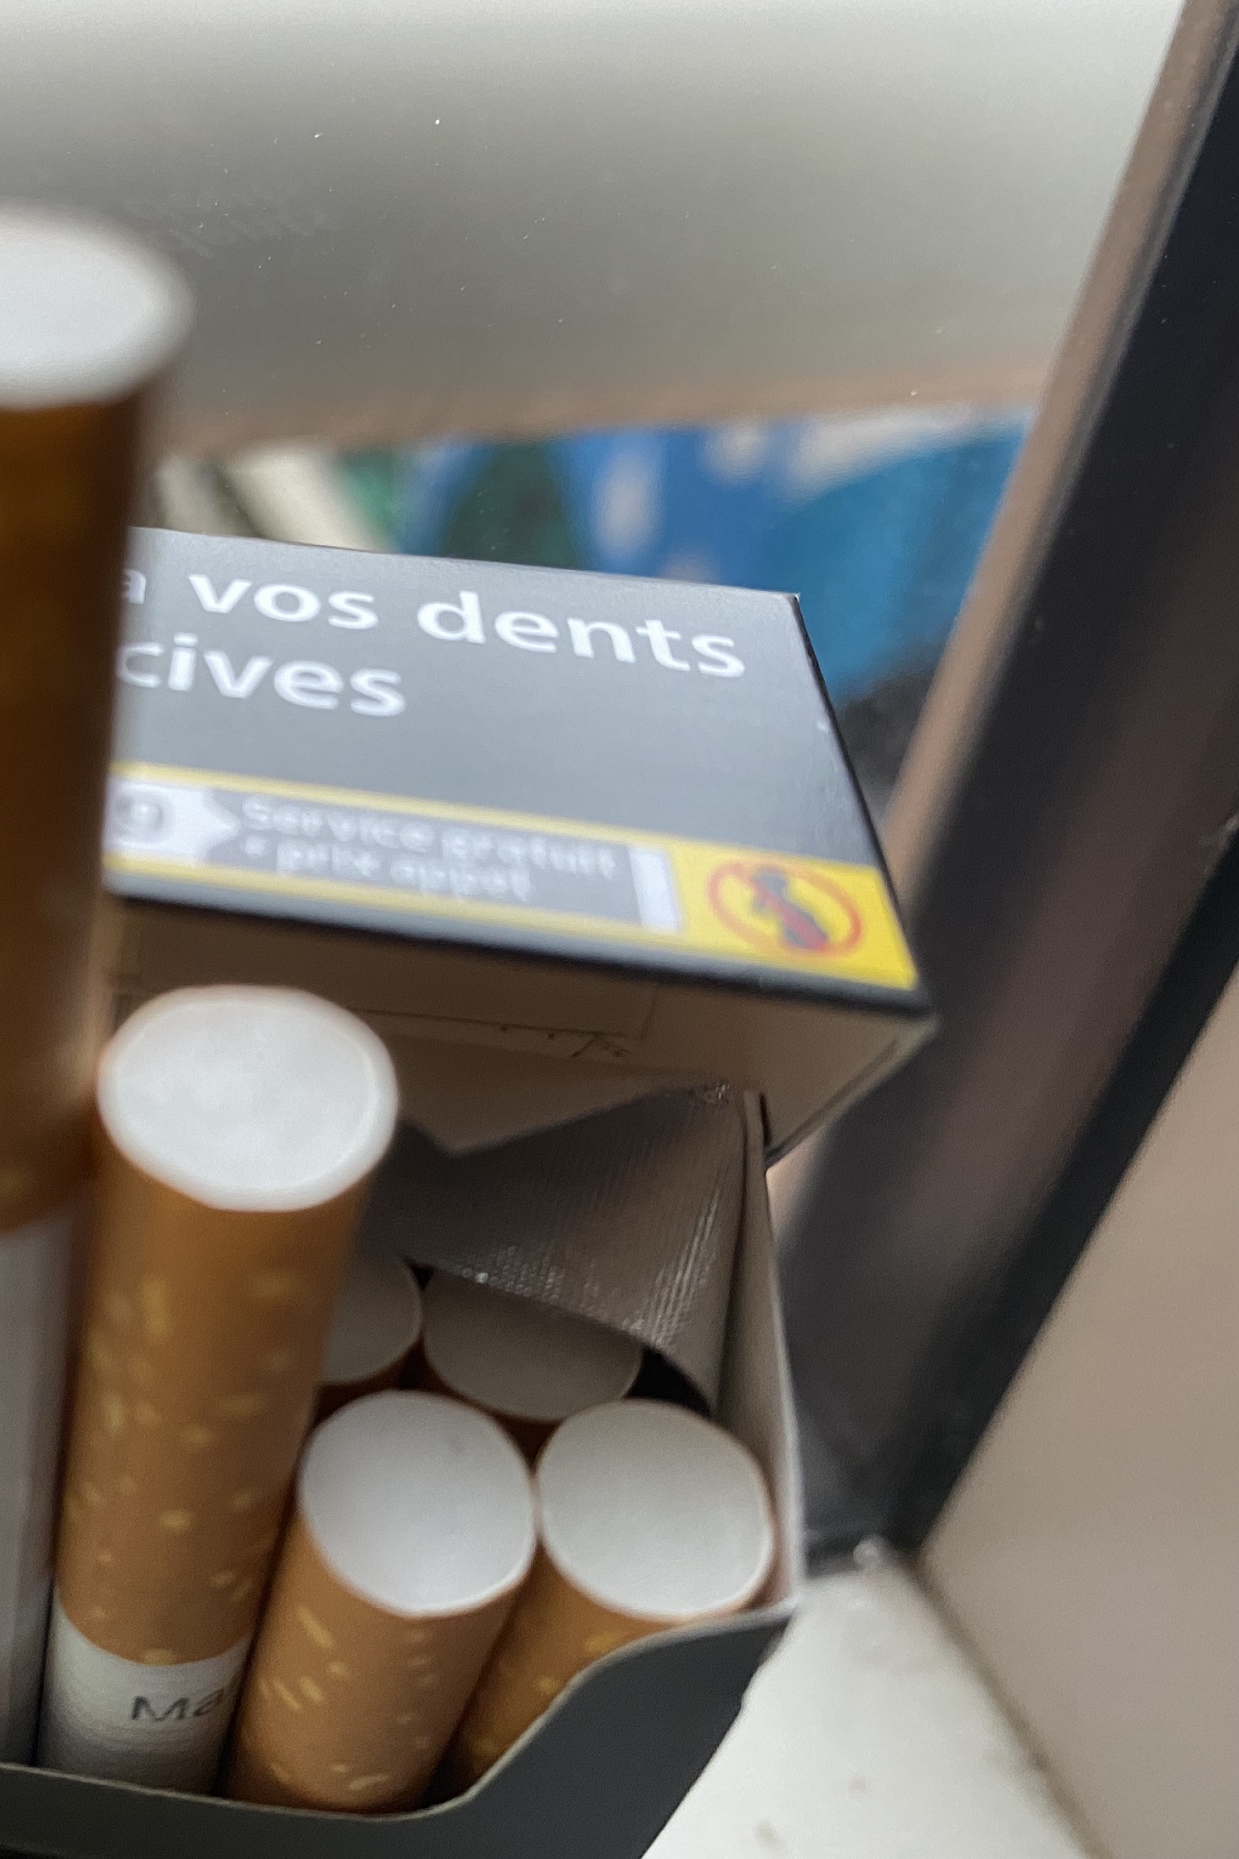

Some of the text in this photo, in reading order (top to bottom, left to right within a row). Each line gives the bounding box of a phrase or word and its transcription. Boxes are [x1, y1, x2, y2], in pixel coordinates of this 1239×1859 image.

[188, 573, 380, 631] vos
[416, 589, 746, 679] dents
[115, 631, 409, 718] cives
[241, 793, 617, 882] Service gratuit
